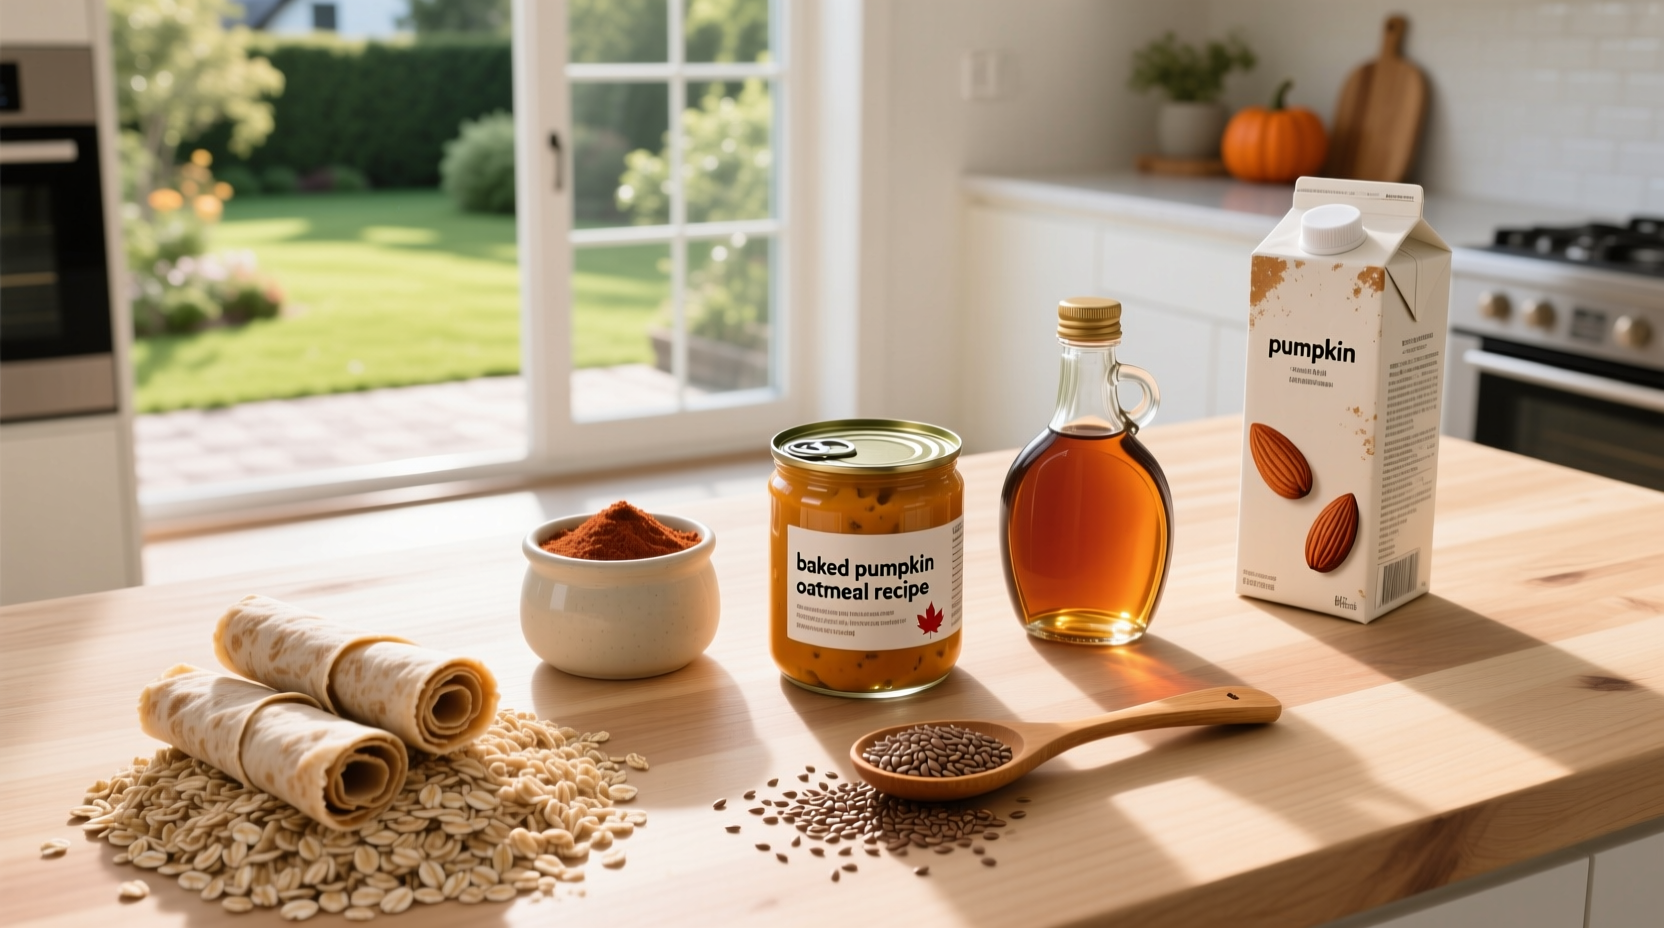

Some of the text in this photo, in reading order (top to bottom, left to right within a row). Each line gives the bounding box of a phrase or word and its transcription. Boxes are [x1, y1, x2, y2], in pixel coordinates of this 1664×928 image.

[1268, 338, 1356, 364] pumpkin
[796, 551, 934, 581] baked pumpkin
[796, 580, 930, 602] oatmeal recipe
